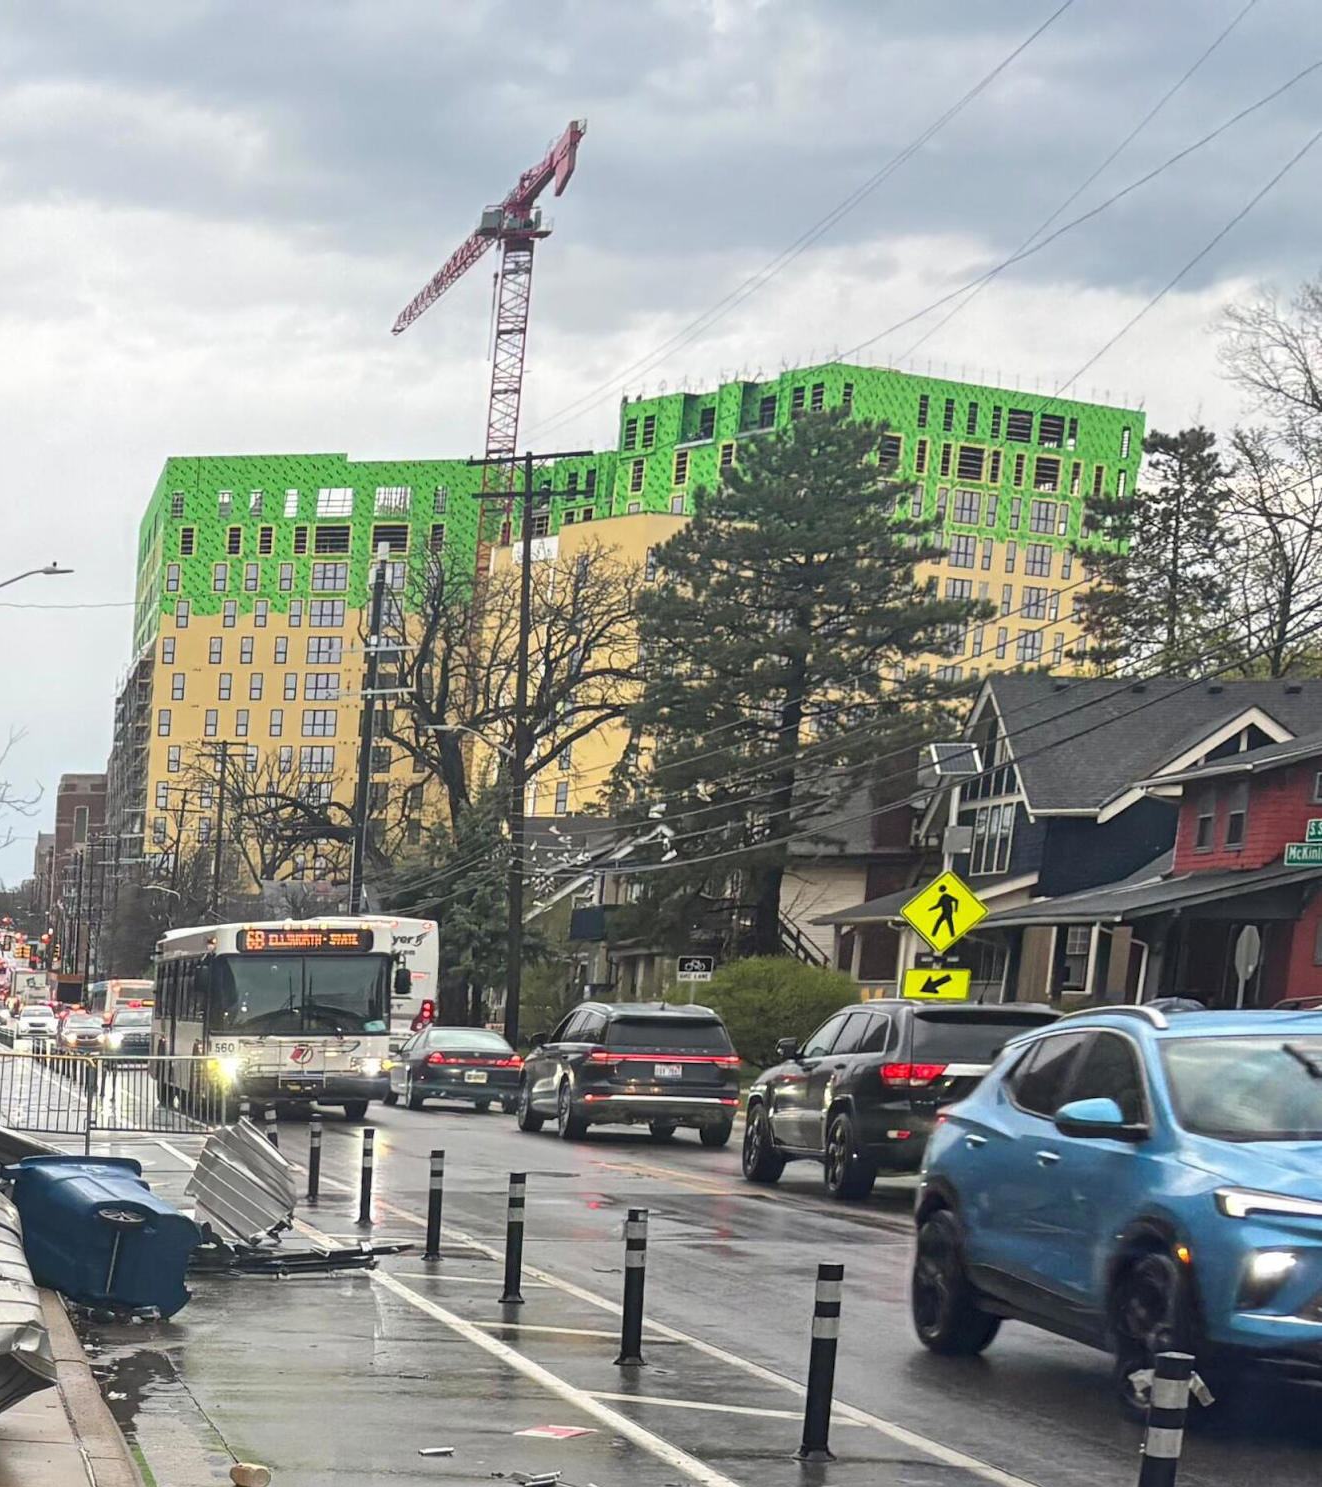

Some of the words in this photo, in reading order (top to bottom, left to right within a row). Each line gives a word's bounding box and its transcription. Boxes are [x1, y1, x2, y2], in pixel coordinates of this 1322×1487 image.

[1317, 821, 1322, 835] S
[1288, 846, 1322, 860] McKinl
[215, 1043, 235, 1053] 560
